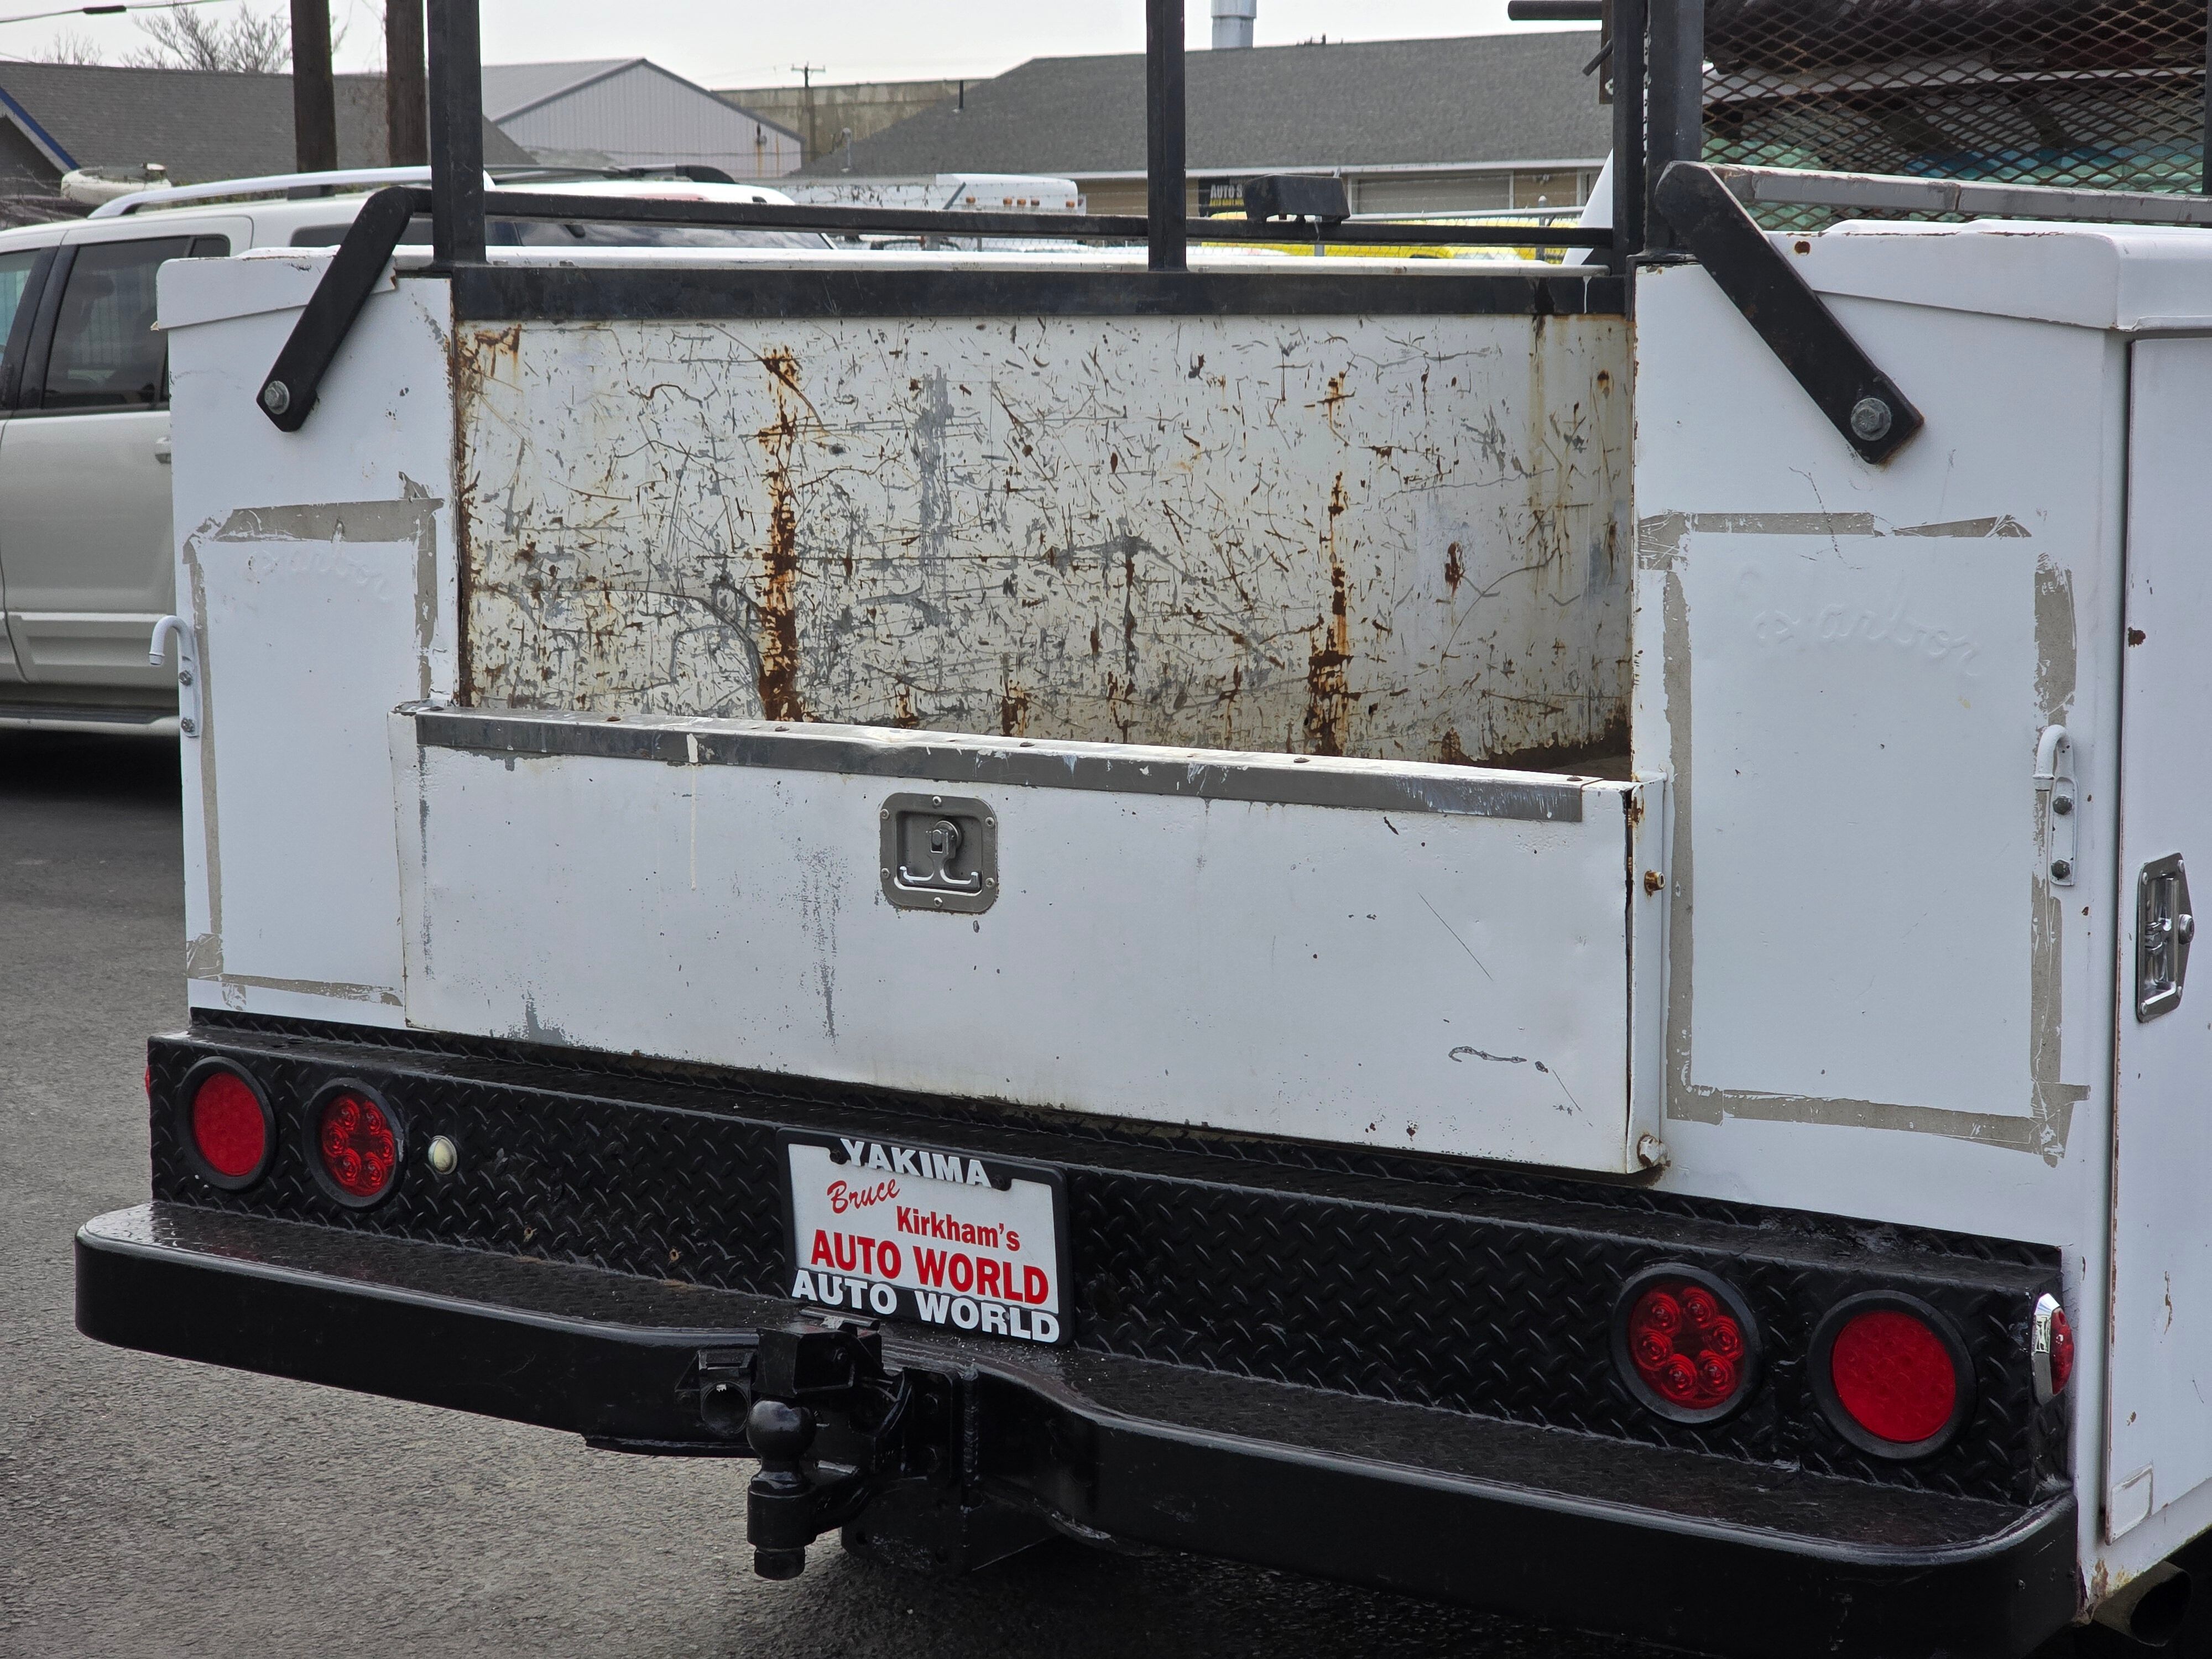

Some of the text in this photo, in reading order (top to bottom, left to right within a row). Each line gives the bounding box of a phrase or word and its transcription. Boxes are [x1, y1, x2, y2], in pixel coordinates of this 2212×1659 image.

[1210, 184, 1234, 199] AUTO
[840, 1138, 992, 1188] YAKIMA
[827, 1179, 900, 1214] Bruce
[896, 1206, 1020, 1251] Kirkham's
[811, 1229, 1049, 1305] AUTO WORLD
[791, 1270, 1060, 1343] AUTO WORLD
